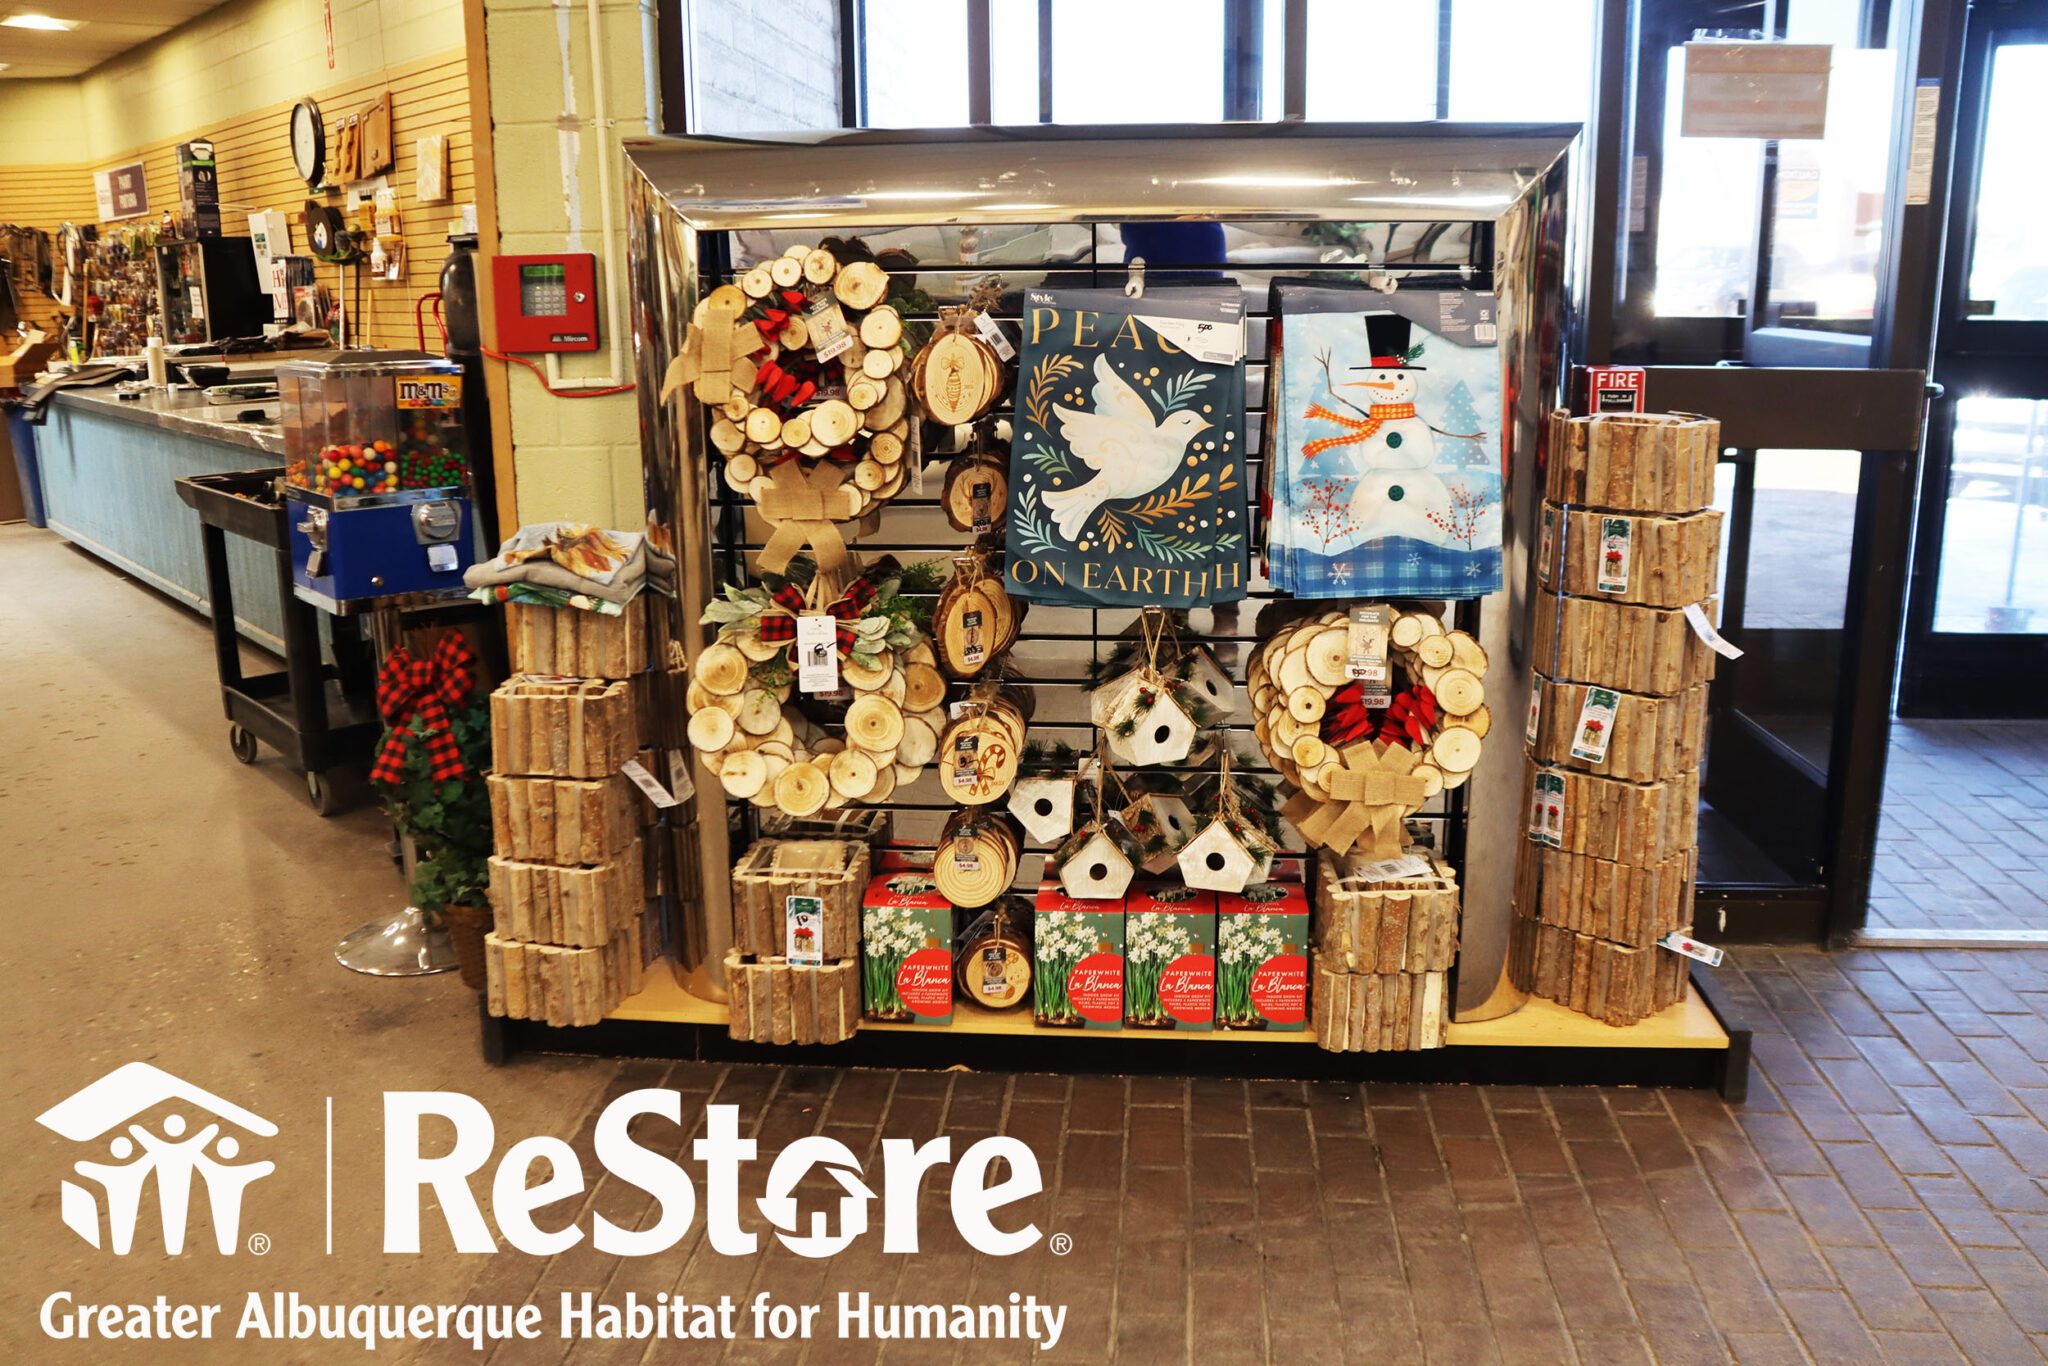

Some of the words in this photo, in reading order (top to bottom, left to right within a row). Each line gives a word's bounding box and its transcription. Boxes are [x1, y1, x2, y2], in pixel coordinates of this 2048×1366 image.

[822, 341, 848, 359] $19.98
[1597, 372, 1640, 388] FIRE
[1011, 559, 1067, 587] ON
[1083, 562, 1209, 598] EARTH
[887, 897, 901, 906] La
[900, 896, 929, 907] Blanca
[897, 971, 912, 985] La
[911, 969, 951, 987] Blanca
[1068, 976, 1082, 991] La
[1083, 974, 1122, 992] Blanca
[1160, 977, 1174, 992] La
[1174, 976, 1214, 993] Blanca
[1251, 978, 1266, 993] La
[1266, 976, 1306, 993] Blanca
